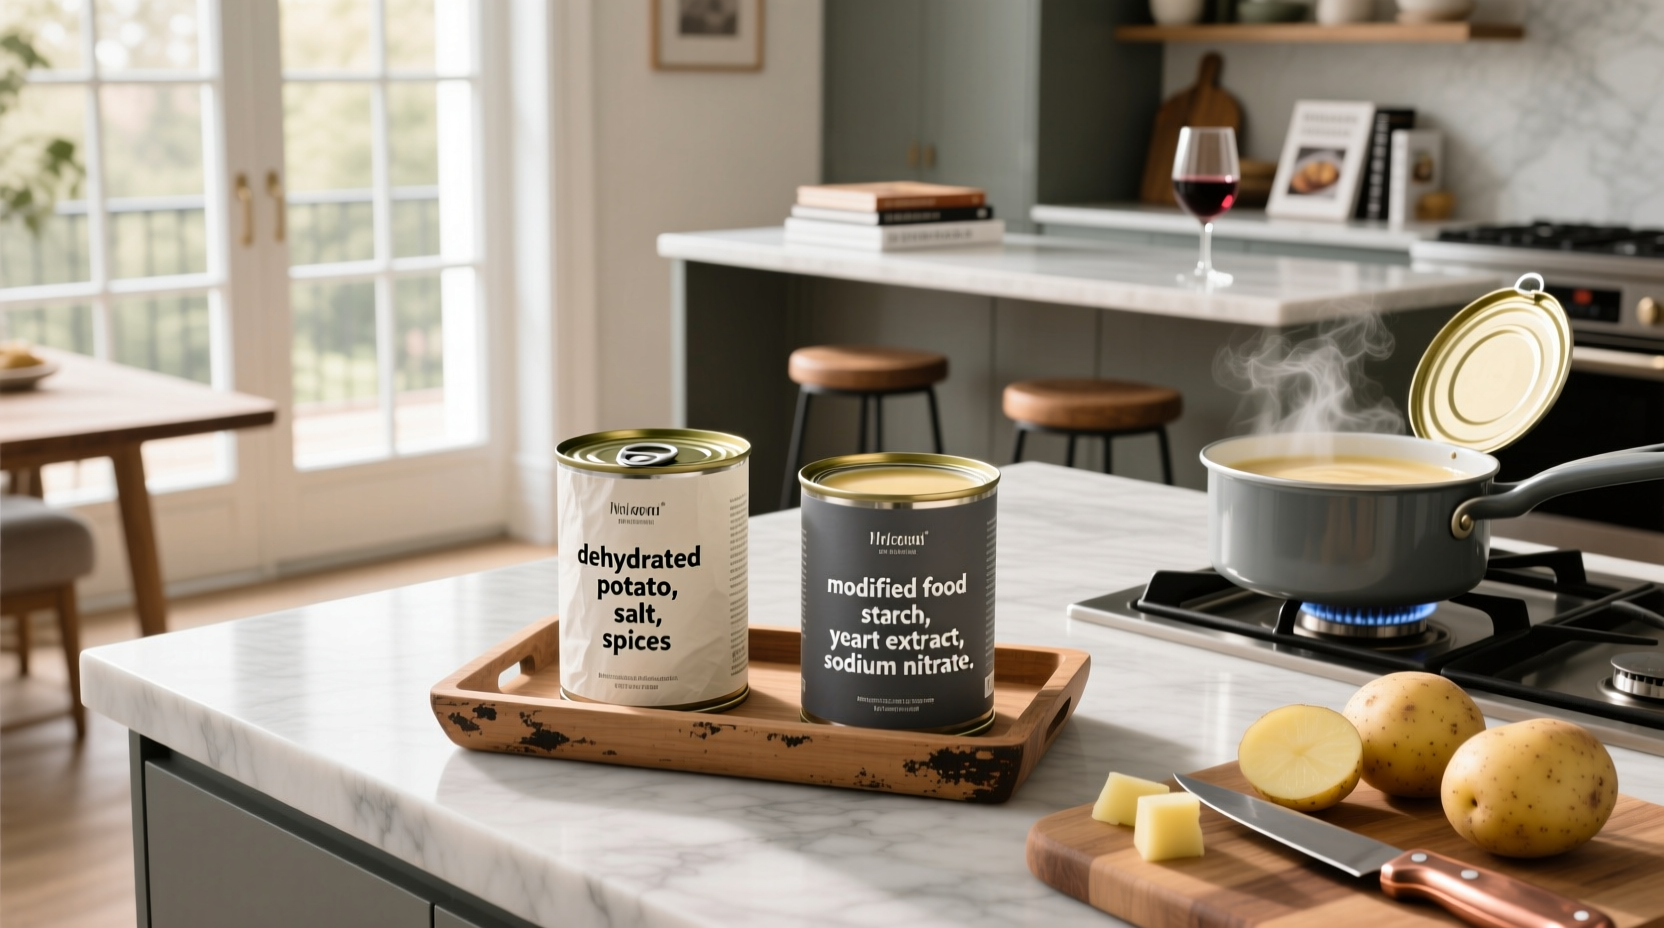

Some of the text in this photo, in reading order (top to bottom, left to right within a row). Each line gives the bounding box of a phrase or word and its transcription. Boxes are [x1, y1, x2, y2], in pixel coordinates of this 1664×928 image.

[578, 543, 701, 574] dehydrated
[597, 577, 678, 600] potato,
[827, 572, 967, 598] modified food
[614, 602, 662, 627] salt,
[861, 604, 931, 628] starch,
[602, 629, 671, 655] spices
[885, 628, 964, 650] extract,
[824, 652, 974, 675] sodium nitrate.
